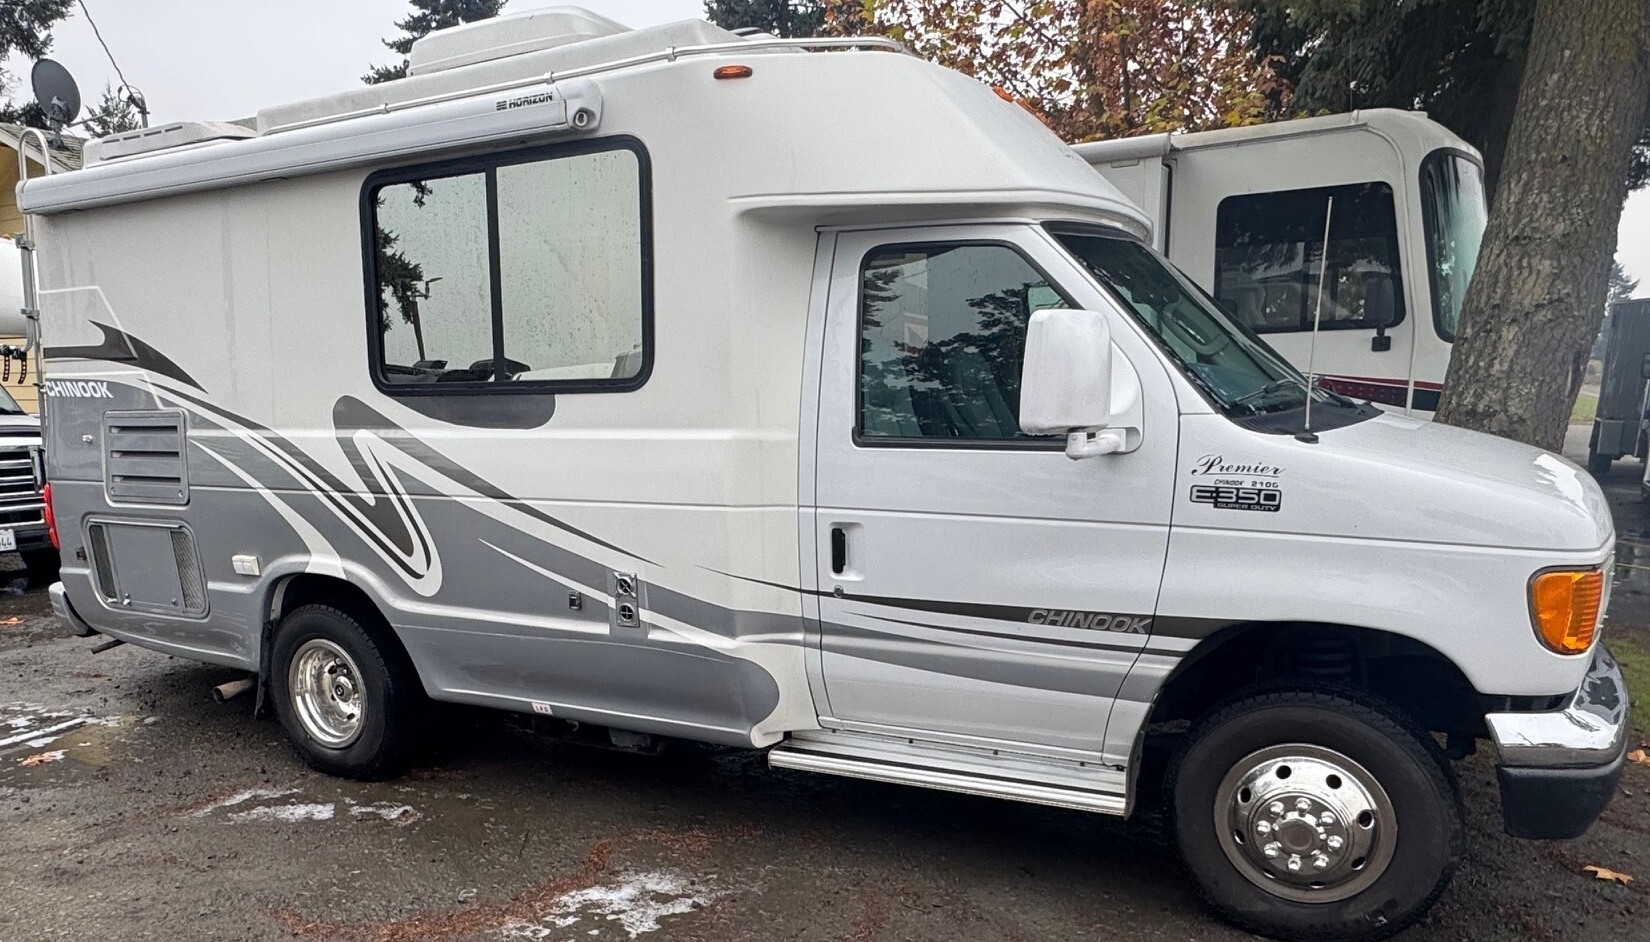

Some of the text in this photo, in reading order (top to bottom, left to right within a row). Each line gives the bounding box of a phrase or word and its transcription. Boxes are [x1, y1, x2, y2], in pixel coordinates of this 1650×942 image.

[508, 91, 553, 109] HORIZON
[45, 381, 114, 398] CHINOOK
[1191, 453, 1286, 476] Premier
[1027, 608, 1152, 634] CHINOOK
